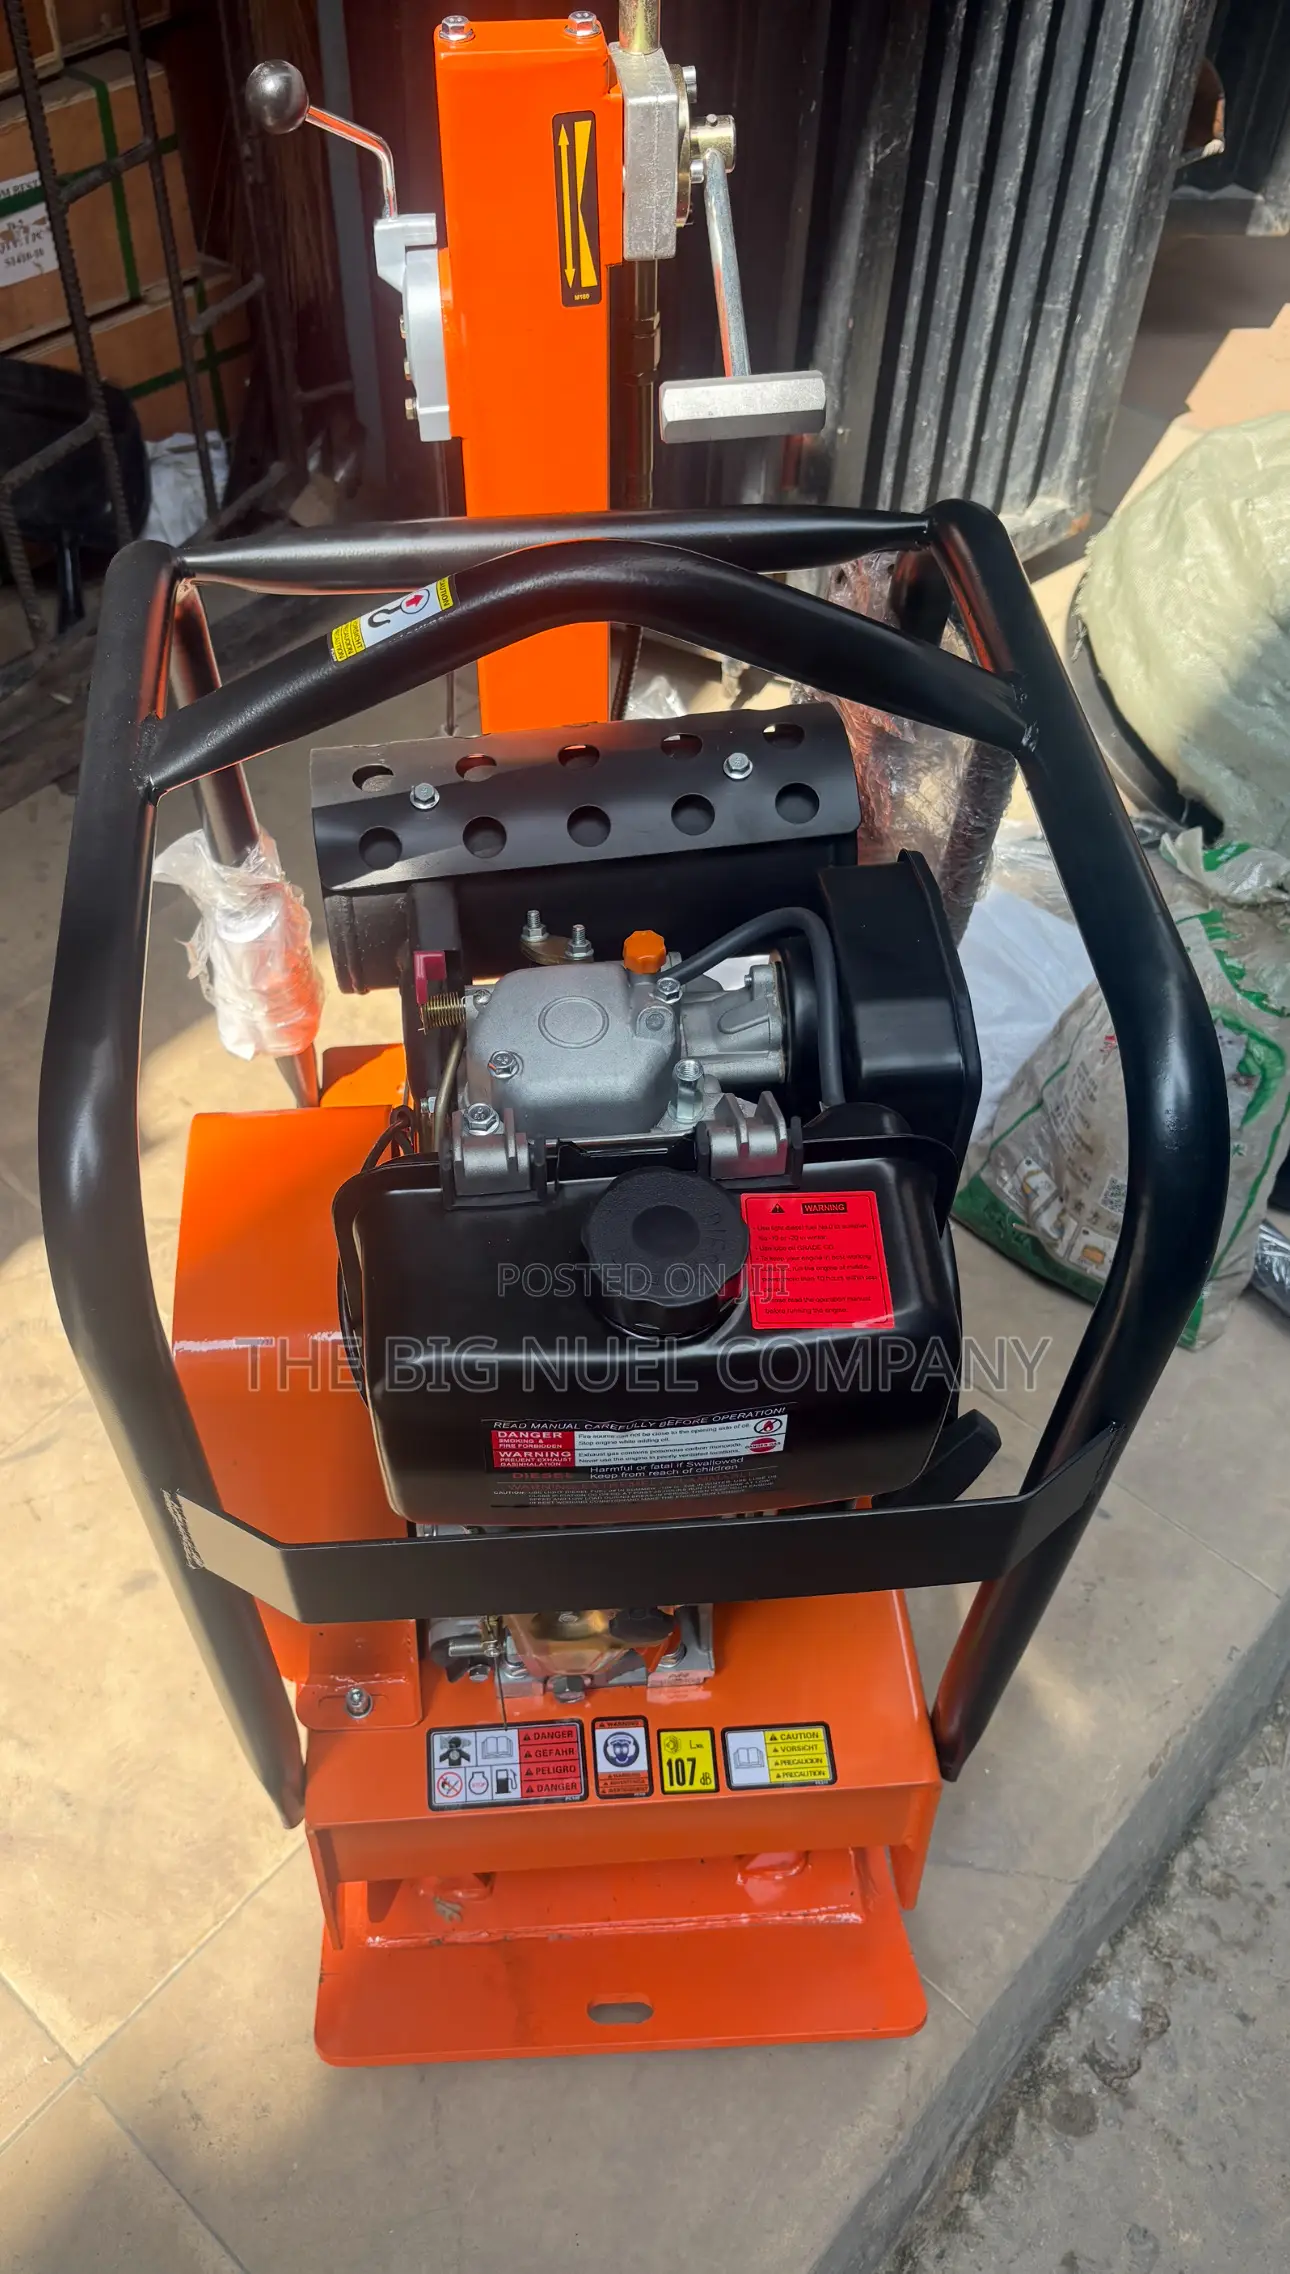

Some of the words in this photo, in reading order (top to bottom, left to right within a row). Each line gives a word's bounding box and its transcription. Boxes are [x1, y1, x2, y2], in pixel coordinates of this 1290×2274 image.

[804, 1203, 845, 1212] WARNING
[846, 1253, 872, 1261] working
[765, 1307, 786, 1315] before
[787, 1307, 812, 1315] running
[493, 1421, 528, 1430] READ
[530, 1422, 581, 1430] MANUAL
[584, 1421, 657, 1432] CAREFULLY
[659, 1416, 709, 1428] BEFORE
[712, 1406, 787, 1422] OPERATION!
[497, 1431, 563, 1439] DANGER
[690, 1427, 717, 1435] opening
[590, 1465, 633, 1474] Harmful
[650, 1461, 673, 1470] fatal
[675, 1460, 685, 1468] if
[686, 1456, 745, 1468] Swallowed
[590, 1472, 618, 1480] Keep
[621, 1470, 645, 1478] from
[648, 1467, 679, 1476] reach
[682, 1465, 693, 1474] of
[695, 1463, 738, 1473] children
[533, 1730, 574, 1740] DANGER
[779, 1731, 819, 1741] CAUTION
[535, 1748, 575, 1758] GEFAHR
[780, 1744, 818, 1752] VORSICHT
[779, 1758, 823, 1766] PRECAUCION
[535, 1765, 577, 1775] PELIGRO
[666, 1757, 697, 1787] 107
[782, 1770, 826, 1778] PRECAUTION
[699, 1772, 712, 1786] dB
[536, 1782, 577, 1793] DANGER
